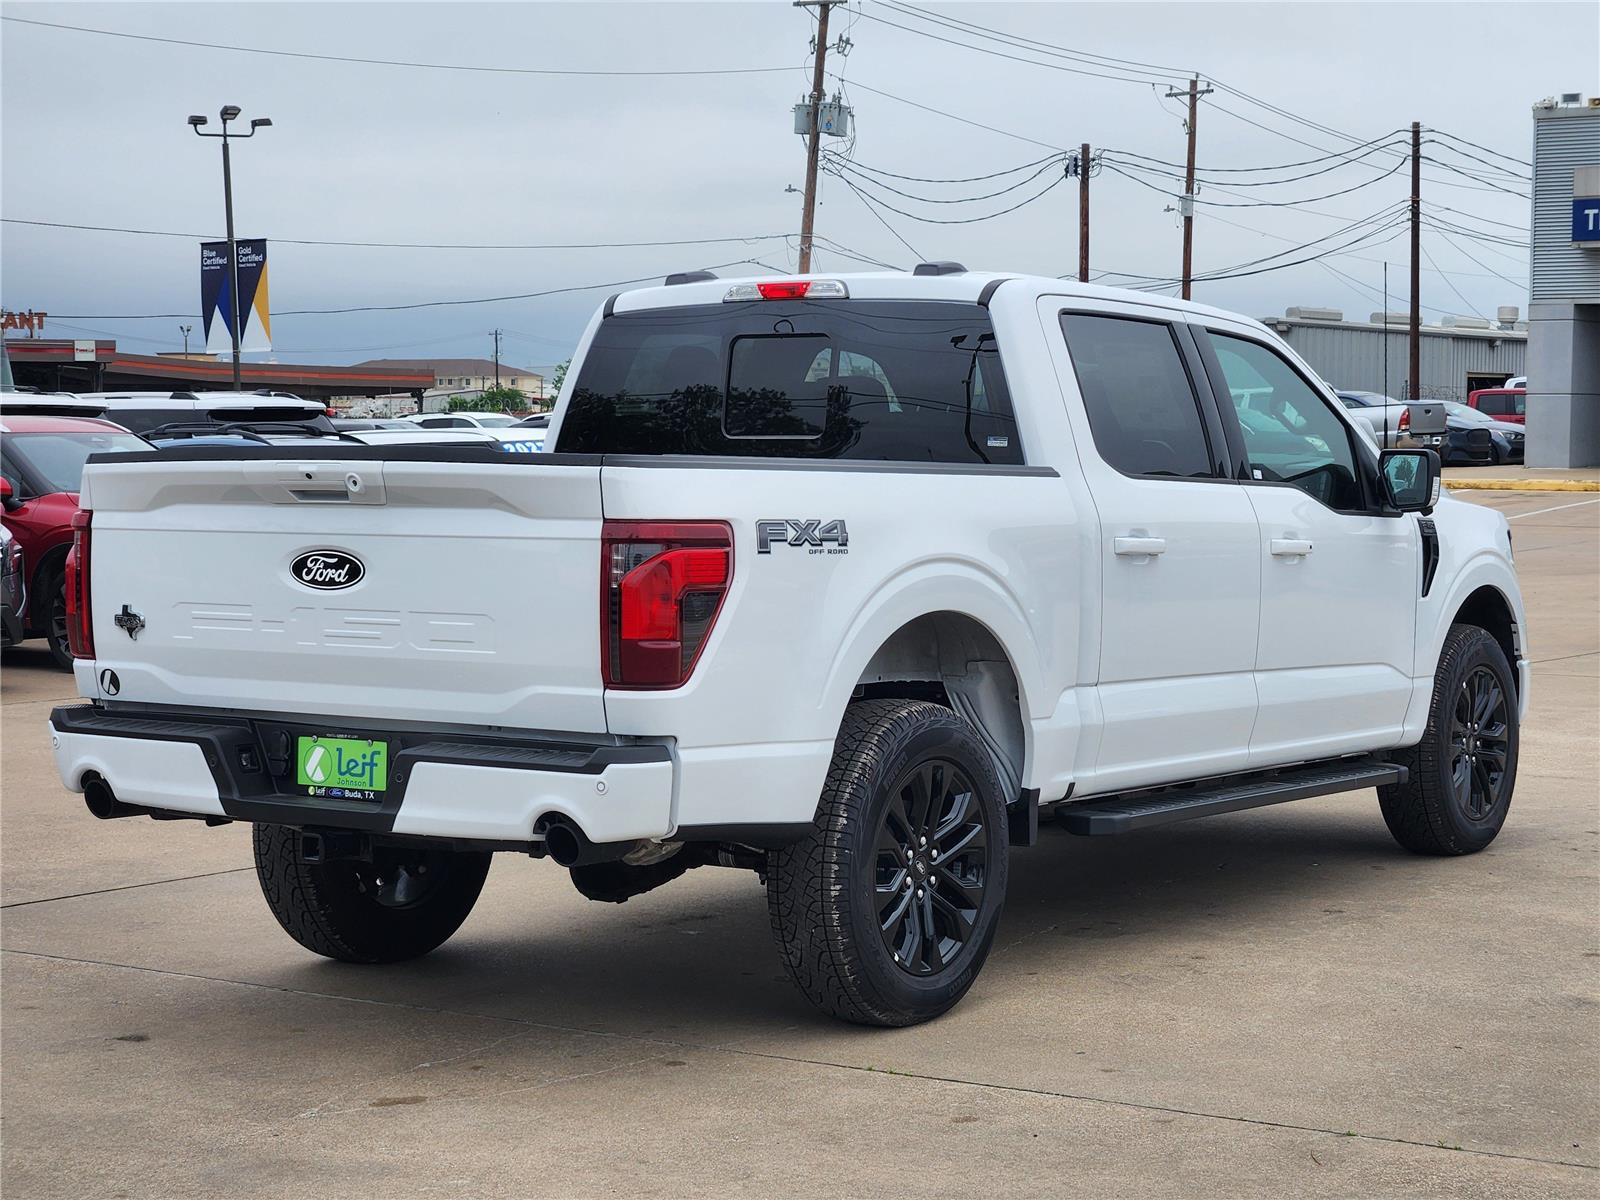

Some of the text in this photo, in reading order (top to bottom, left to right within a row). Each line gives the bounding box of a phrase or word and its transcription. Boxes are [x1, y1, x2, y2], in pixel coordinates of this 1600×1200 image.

[1584, 208, 1600, 230] T
[203, 257, 227, 265] Certified
[239, 254, 262, 262] Certified
[755, 518, 849, 554] FX4
[302, 555, 350, 583] Ford
[336, 777, 367, 787] Johnson
[344, 789, 363, 799] Buda,
[364, 791, 375, 799] TX
